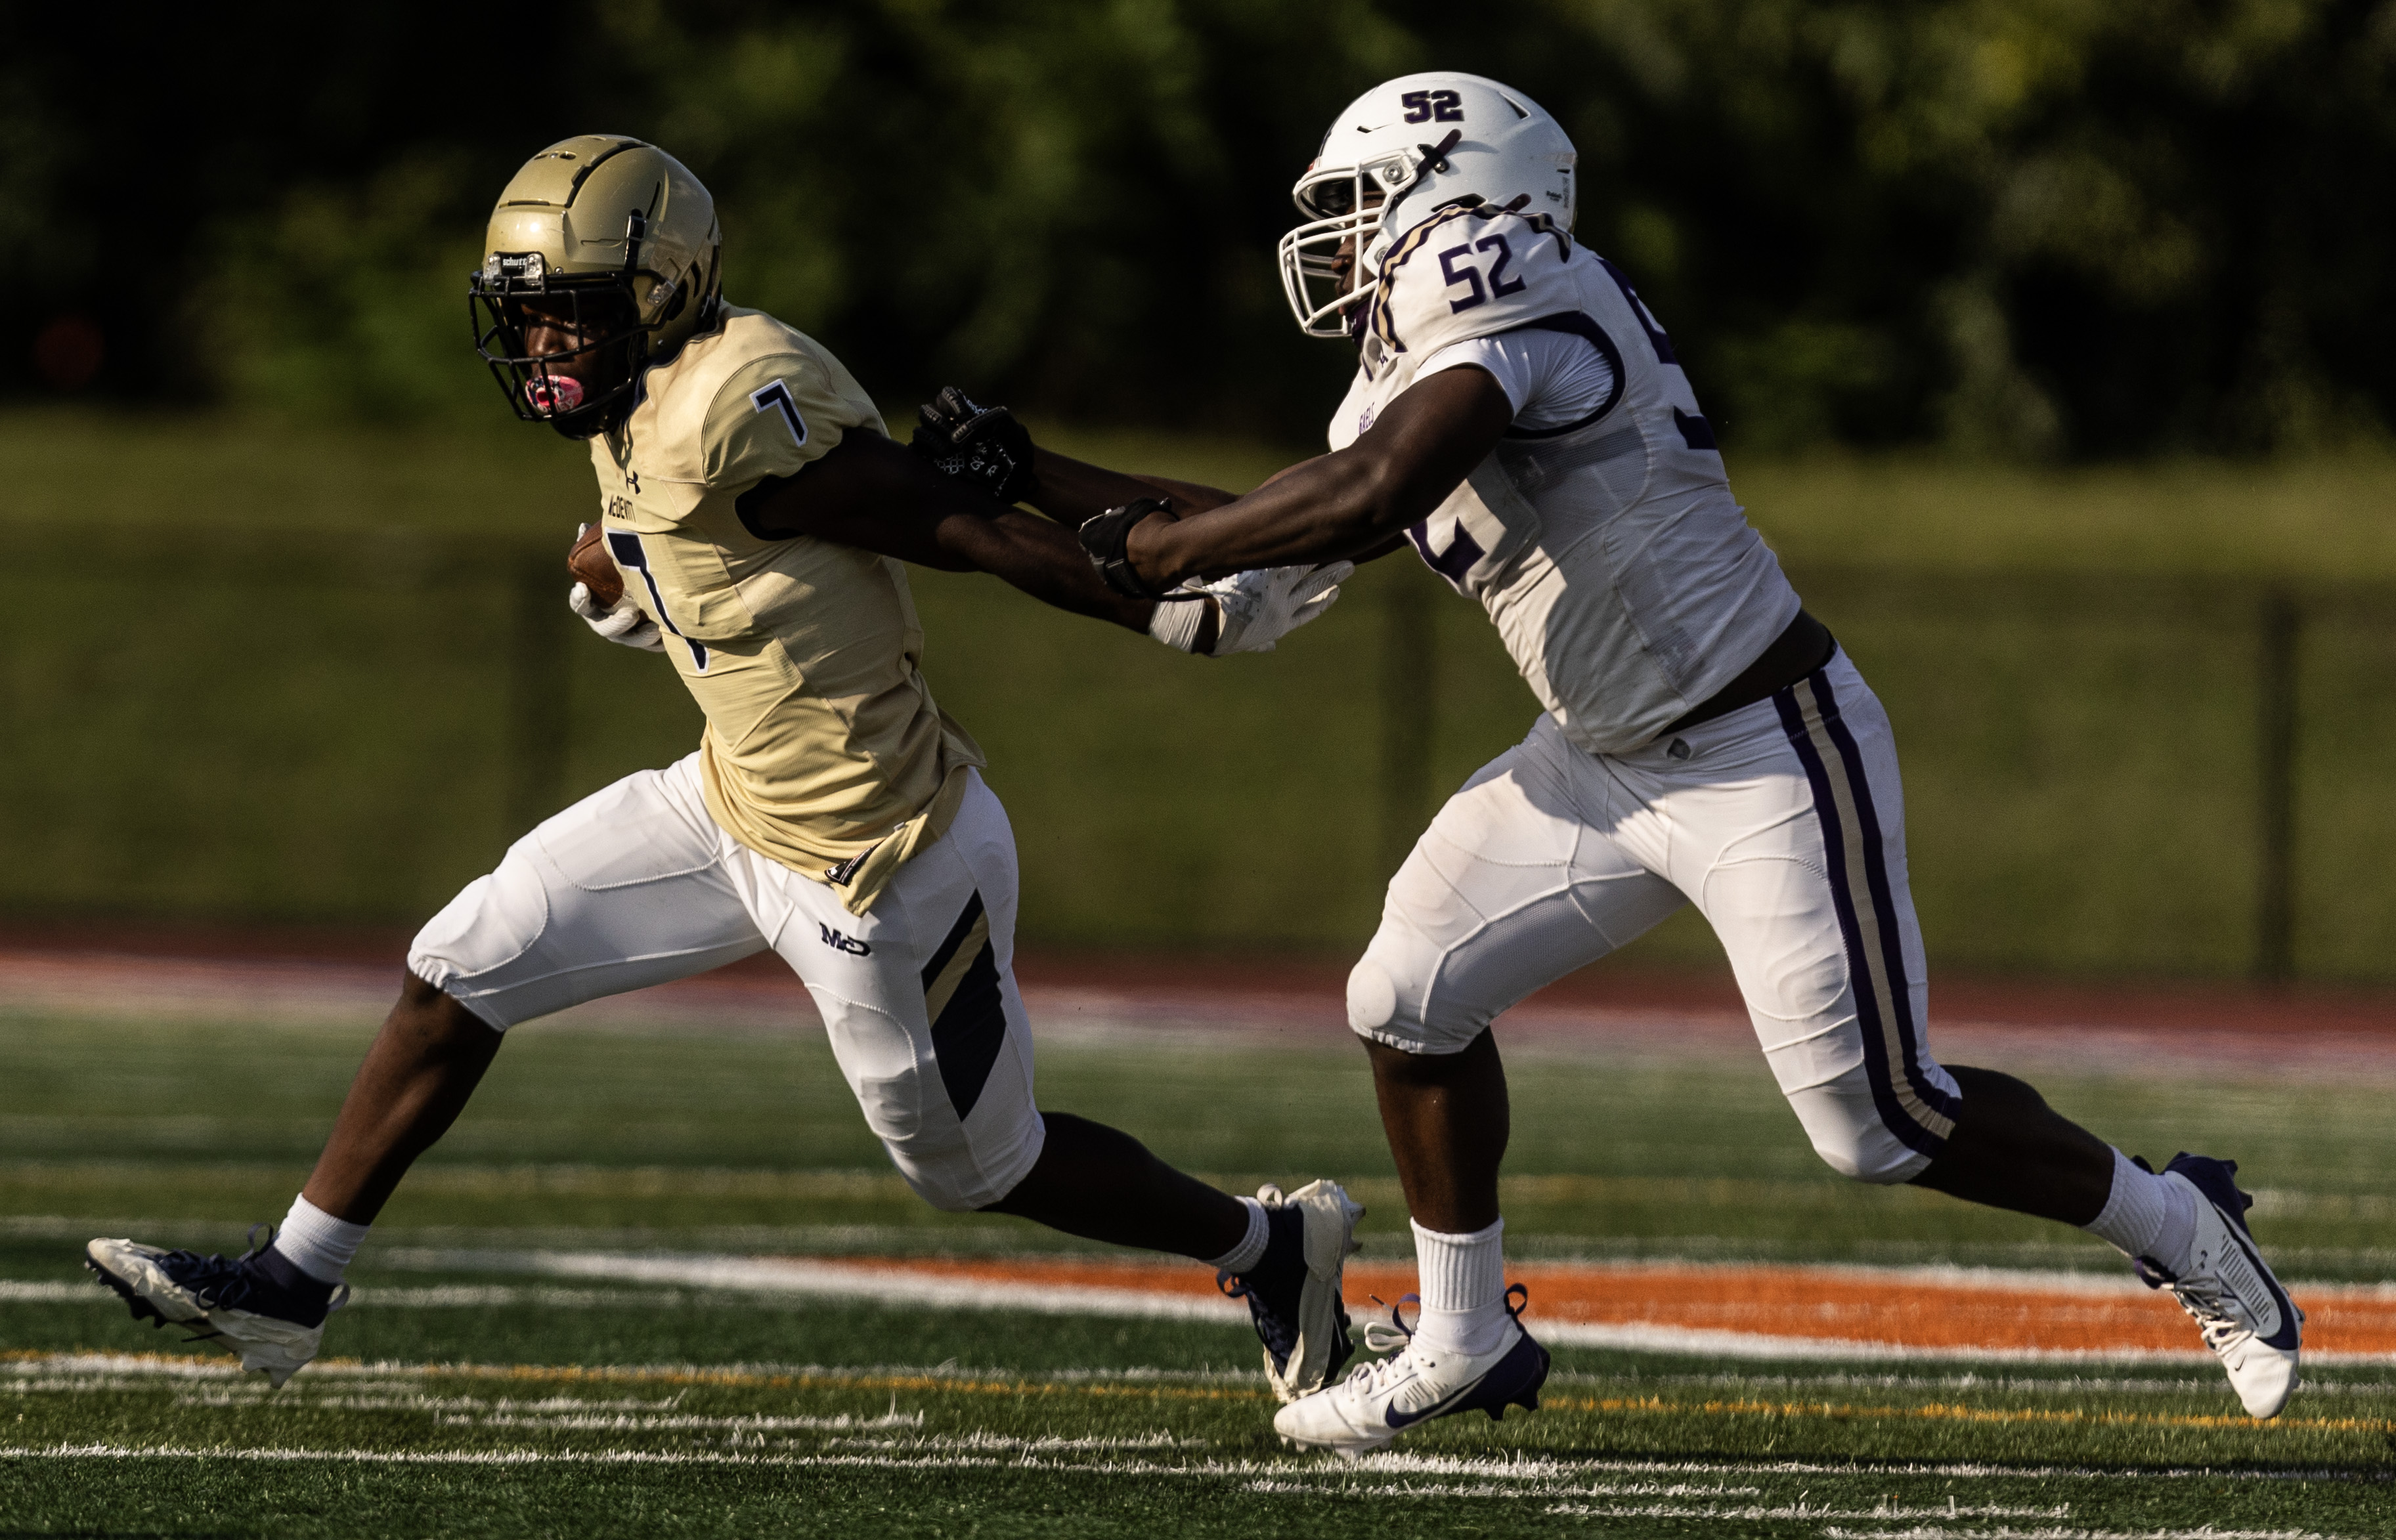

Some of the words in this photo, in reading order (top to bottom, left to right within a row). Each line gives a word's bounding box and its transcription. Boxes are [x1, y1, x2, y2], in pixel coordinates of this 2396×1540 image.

[1401, 89, 1465, 124] 52
[1438, 233, 1527, 314] 52
[749, 378, 808, 448] 7
[604, 526, 711, 675] 7
